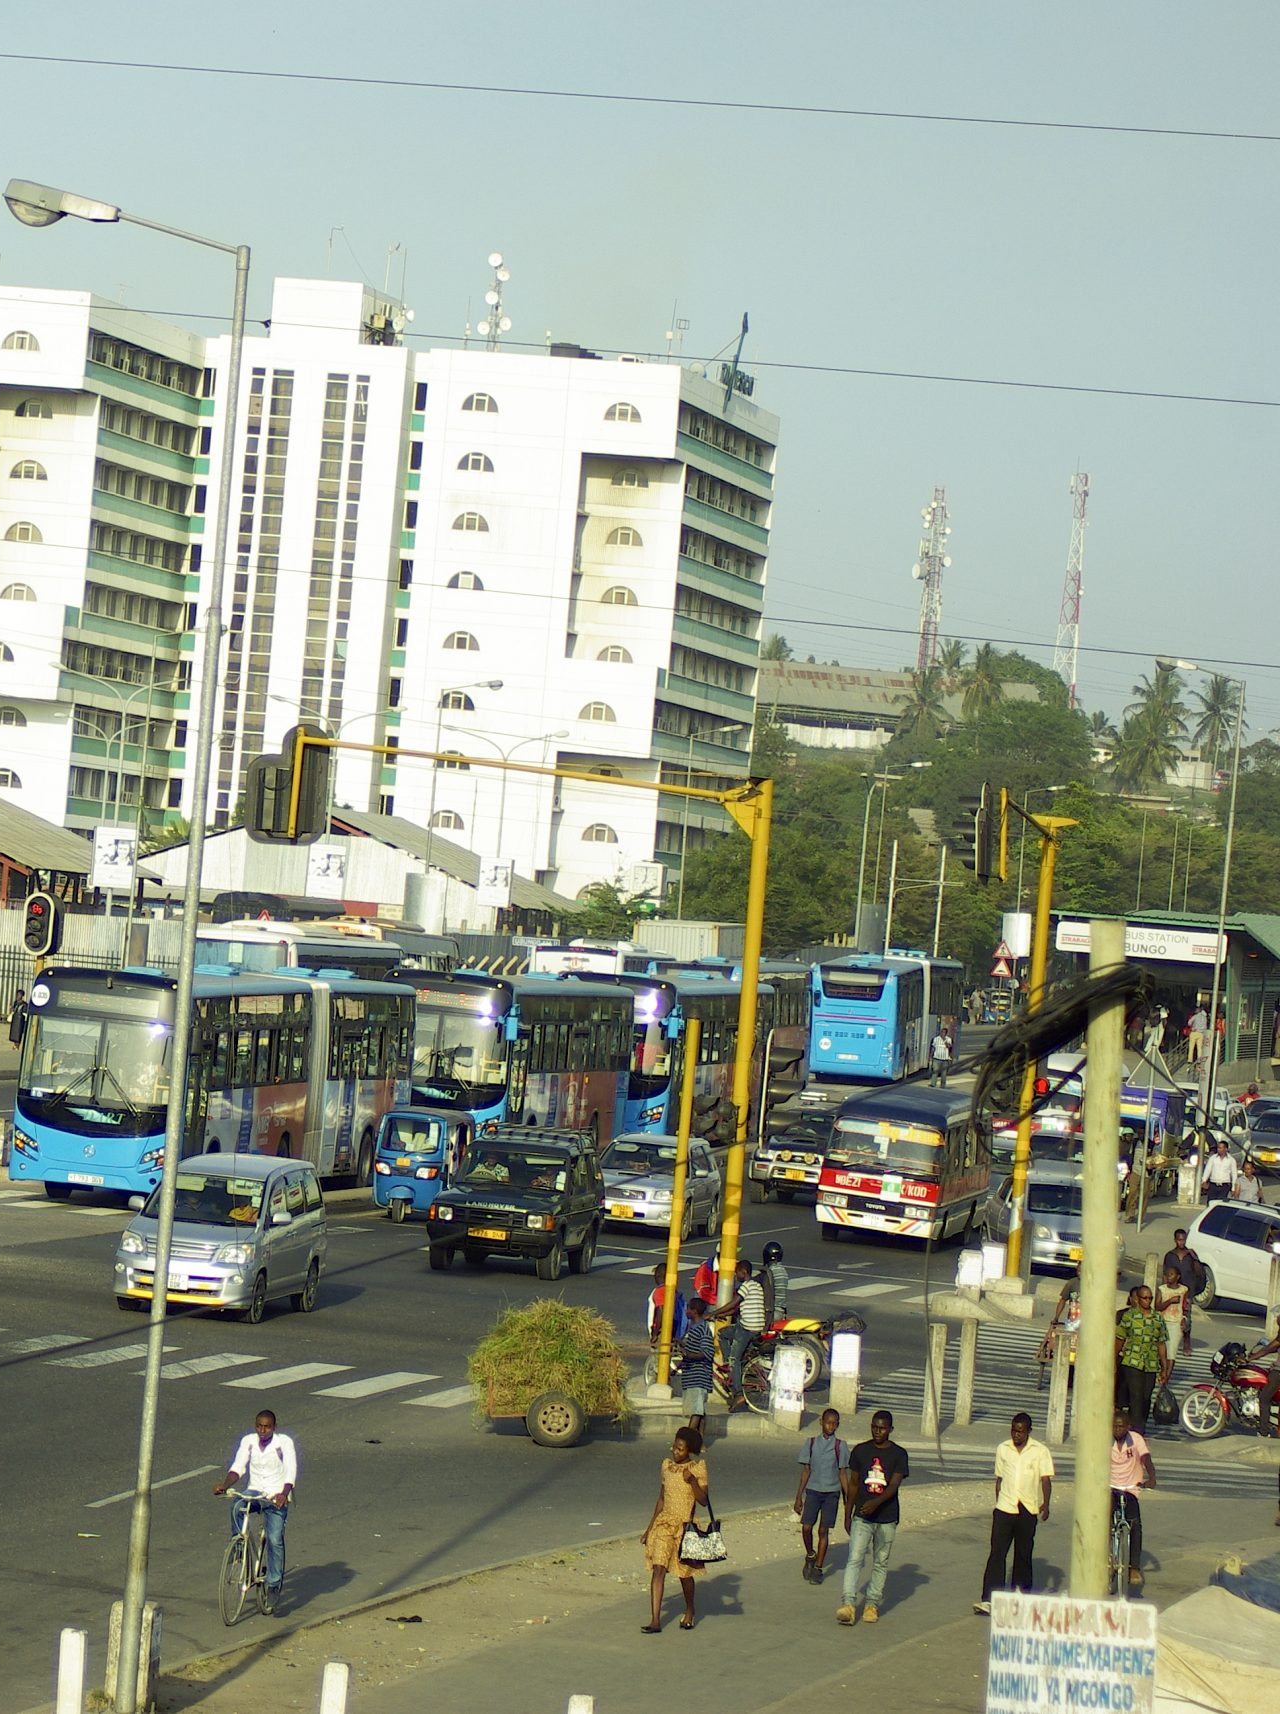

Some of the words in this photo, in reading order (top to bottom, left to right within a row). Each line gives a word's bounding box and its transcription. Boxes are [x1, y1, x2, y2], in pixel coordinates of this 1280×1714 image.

[1125, 931, 1144, 940] BUS
[1147, 933, 1189, 944] STATION
[1124, 942, 1167, 955] BUNGO
[835, 1174, 861, 1188] MBEZI
[1026, 1637, 1040, 1665] ZA
[989, 1670, 1038, 1702] MAUMIVU
[1046, 1677, 1061, 1705] YA
[1066, 1679, 1133, 1711] MGONGO
